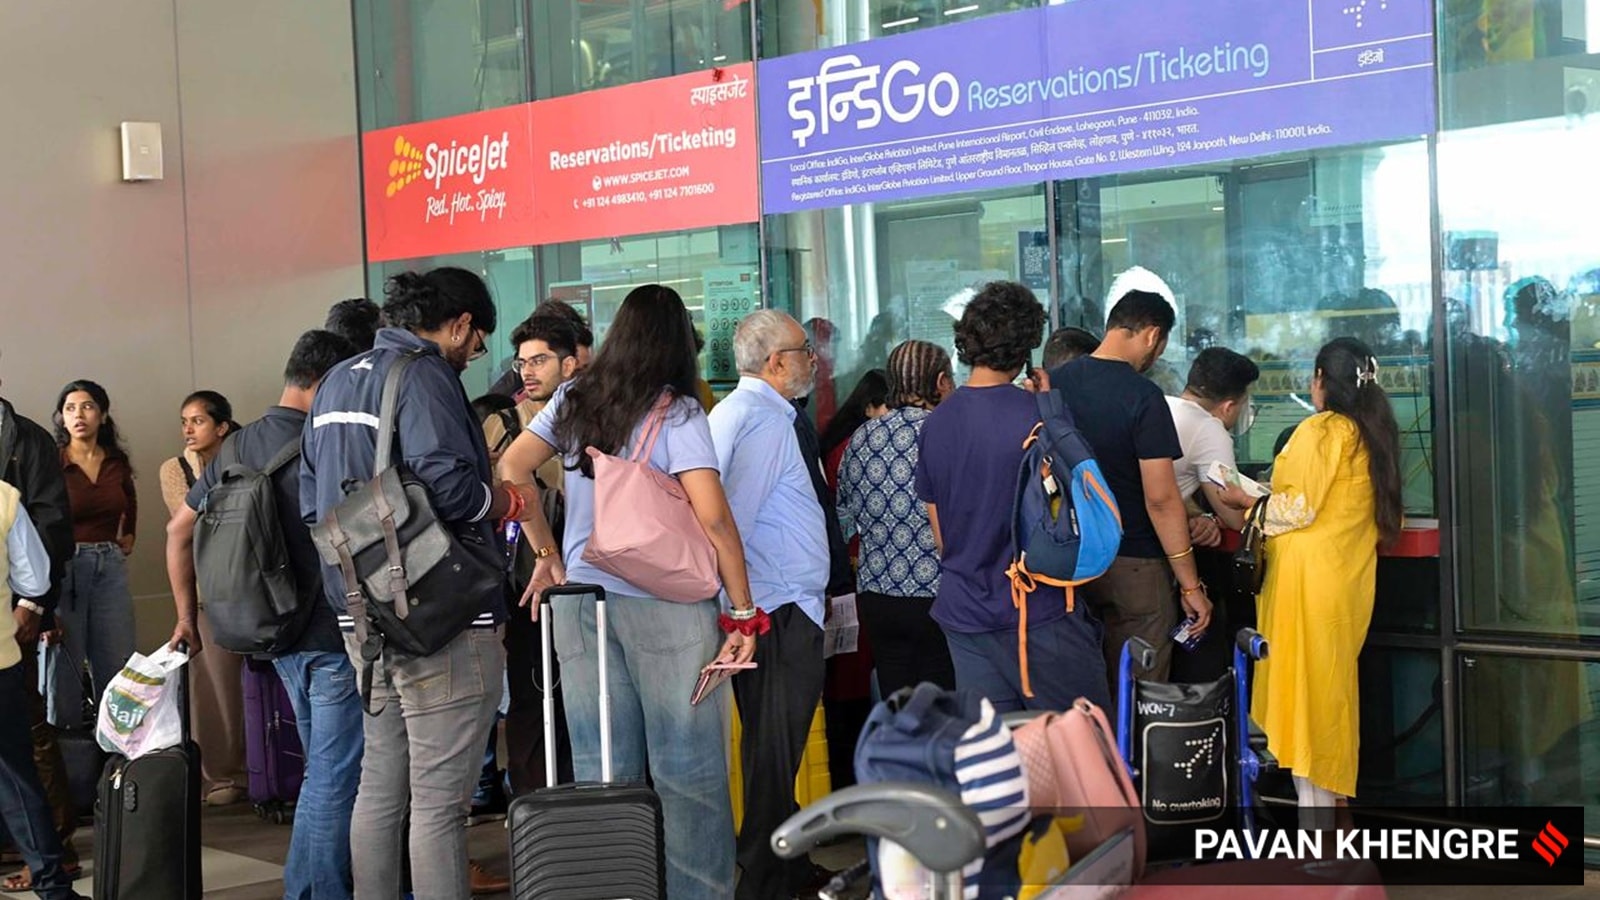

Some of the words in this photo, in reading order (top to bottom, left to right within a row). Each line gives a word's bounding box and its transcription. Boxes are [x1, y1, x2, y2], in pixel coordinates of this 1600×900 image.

[690, 74, 748, 106] स्पाइसजेट
[968, 42, 1270, 112] Reservations/Ticketing
[424, 131, 510, 190] SpiceJet
[549, 126, 736, 171] Reservations/Ticketing
[603, 166, 690, 187] WWW.SPICEJET.COM
[426, 193, 449, 223] Red.
[450, 191, 475, 225] Hot.
[476, 187, 507, 222] Spicy.
[597, 195, 610, 207] 124
[663, 187, 677, 198] 124
[680, 183, 715, 195] 7101600
[1152, 799, 1167, 812] No
[1169, 796, 1221, 812] overtaking
